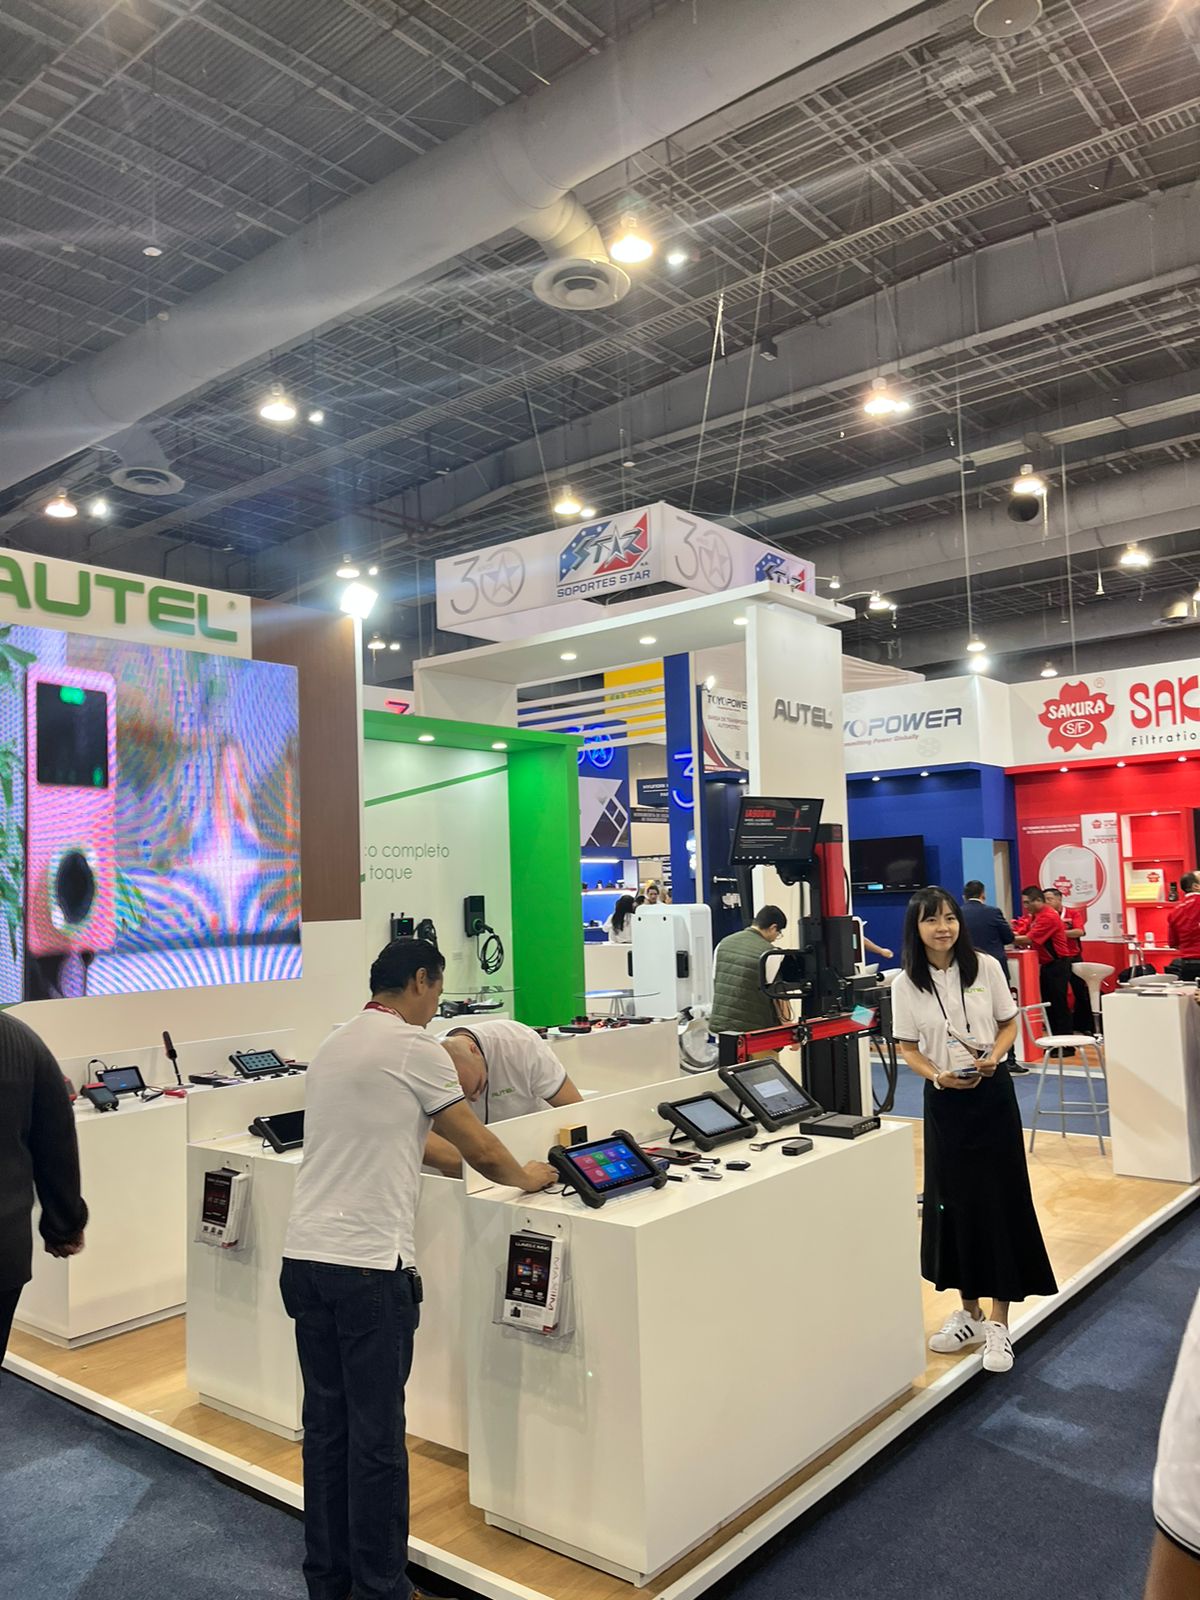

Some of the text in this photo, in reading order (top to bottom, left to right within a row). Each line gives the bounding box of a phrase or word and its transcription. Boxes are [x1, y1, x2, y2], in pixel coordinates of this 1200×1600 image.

[556, 569, 651, 598] SOPORTES STAR
[773, 698, 833, 730] AUTEL
[1047, 699, 1106, 720] SAKURA
[843, 706, 963, 738] OPOWER
[1131, 731, 1197, 746] Filtratio
[381, 842, 451, 861] completo
[369, 865, 413, 883] toque
